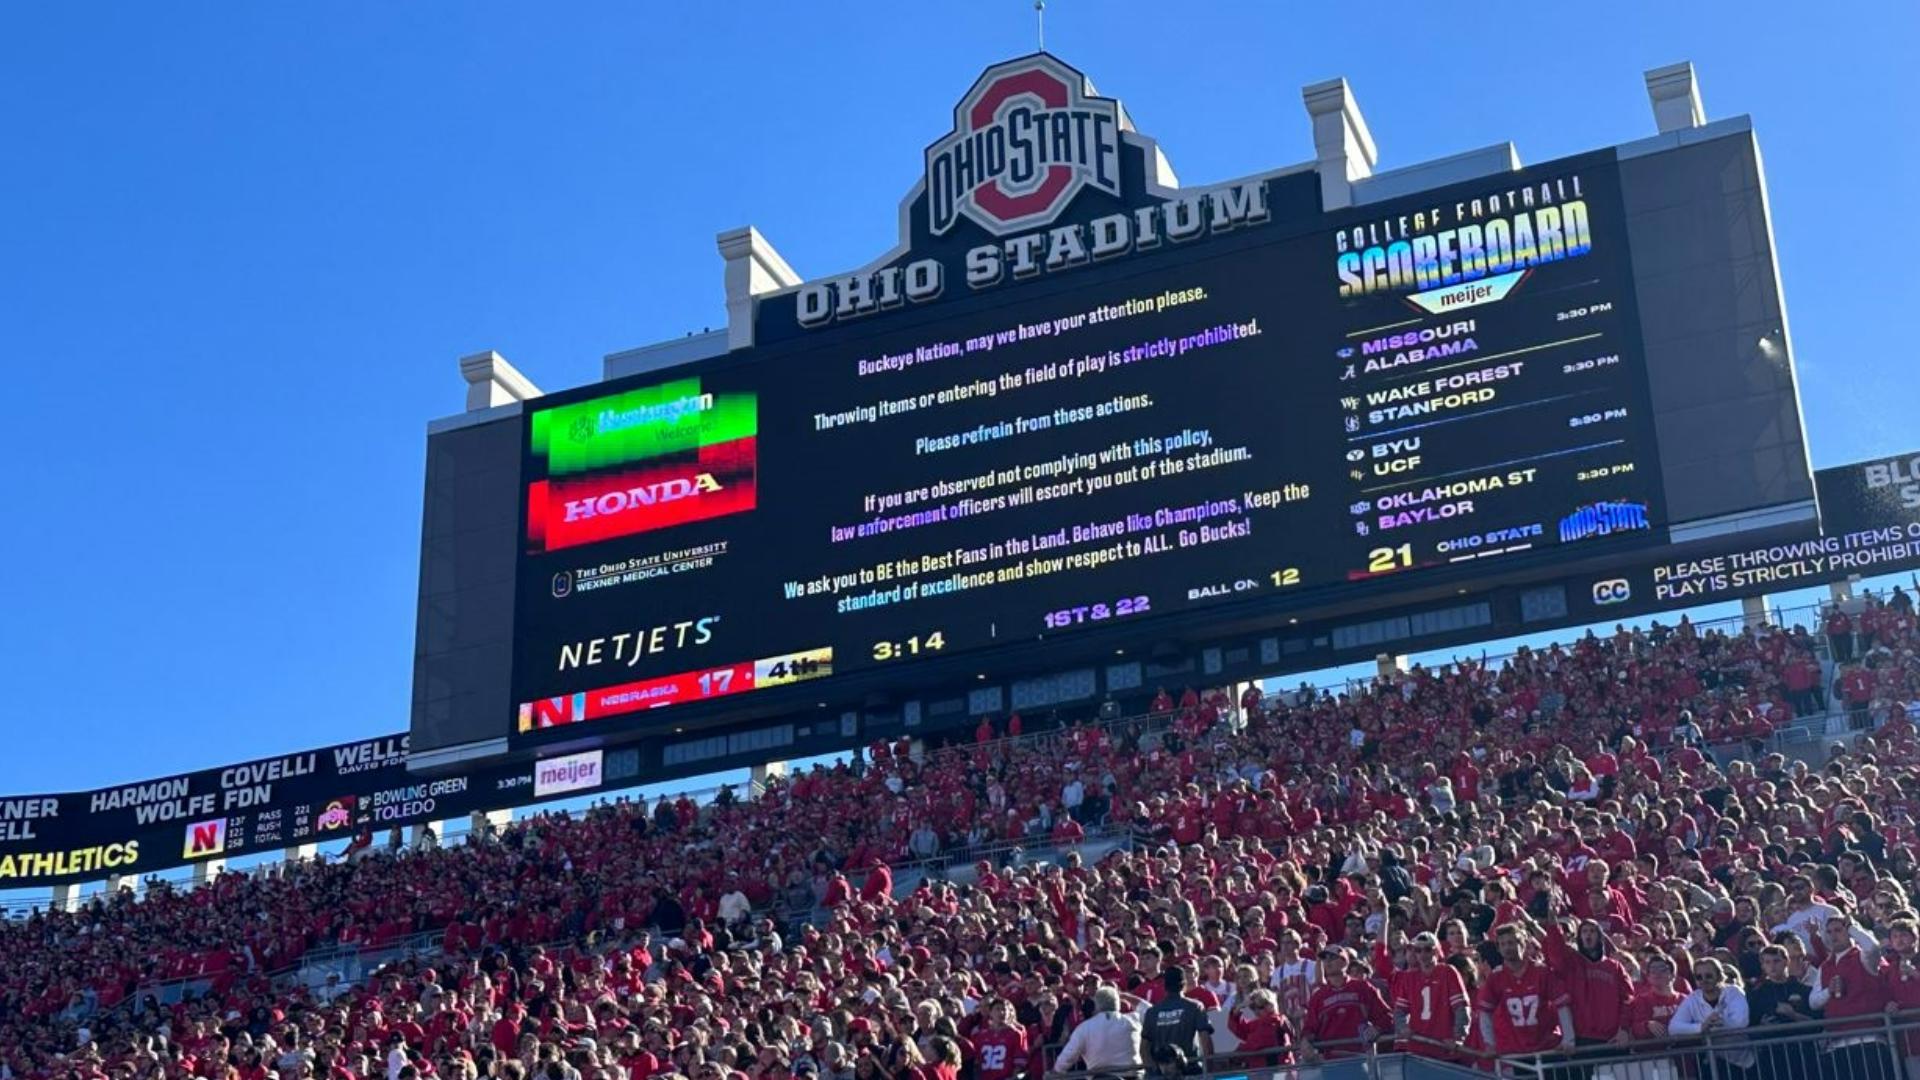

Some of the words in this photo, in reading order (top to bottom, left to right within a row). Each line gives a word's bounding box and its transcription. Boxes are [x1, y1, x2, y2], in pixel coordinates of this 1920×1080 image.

[797, 258, 945, 329] OHIO
[966, 180, 1271, 289] STADIUM
[1337, 200, 1592, 298] SCOREBOARD
[1440, 283, 1493, 307] meijer
[1590, 302, 1613, 314] PM
[857, 351, 914, 376] Buckeye
[914, 341, 964, 363] Nation,
[964, 333, 995, 352] may
[995, 328, 1017, 346] we
[1017, 320, 1052, 341] have
[1052, 312, 1086, 336] your
[1087, 297, 1154, 324] attention
[1155, 286, 1208, 313] please.
[1362, 320, 1476, 355] MISSOURI
[1364, 338, 1479, 373] ALABAMA
[1597, 354, 1620, 367] PM
[813, 405, 877, 431] Throwing
[878, 396, 917, 417] items
[917, 392, 936, 408] or
[936, 379, 997, 404] entering
[997, 373, 1022, 390] the
[1023, 363, 1056, 385] field
[1058, 359, 1075, 378] of
[1075, 354, 1106, 378] play
[1107, 351, 1122, 367] is
[1121, 338, 1177, 364] strictly
[1177, 320, 1262, 355] prohibited.
[1366, 382, 1431, 406] WAKE
[1435, 362, 1524, 393] FOREST
[915, 433, 961, 455] Please
[960, 421, 1014, 445] refrain
[1013, 414, 1052, 434] from
[1052, 405, 1094, 426] these
[1095, 393, 1153, 417] actions.
[1368, 387, 1496, 424] STANFORD
[1604, 407, 1628, 421] PM
[1371, 436, 1421, 459] BYU
[1373, 455, 1421, 476] UCF
[863, 496, 876, 513] If
[876, 491, 903, 513] you
[903, 486, 929, 504] are
[929, 472, 995, 499] observed
[996, 467, 1021, 485] not
[1022, 452, 1097, 480] complying
[1098, 444, 1132, 464] with
[1132, 438, 1163, 457] this
[1163, 428, 1213, 455] policy,
[1612, 462, 1635, 475] PM
[564, 473, 723, 523] HONDA
[830, 525, 856, 543] law
[856, 505, 948, 537] enforcement
[948, 494, 1006, 519] officers
[1006, 487, 1033, 507] will
[1034, 478, 1084, 501] escort
[1085, 473, 1112, 495] you
[1113, 467, 1138, 486] out
[1139, 463, 1156, 480] of
[1157, 458, 1184, 476] the
[1185, 445, 1252, 471] stadium.
[1377, 475, 1504, 511] OKLAHOMA
[1507, 468, 1537, 485] ST
[1378, 500, 1475, 530] BAYLOR
[783, 581, 805, 599] We
[806, 576, 831, 595] ask
[831, 572, 857, 594] you
[858, 568, 875, 584] to
[875, 563, 893, 581] BE
[894, 560, 919, 577] the
[920, 552, 953, 573] Best
[954, 546, 988, 566] Fans
[988, 543, 1003, 560] in
[1003, 538, 1030, 556] the
[1031, 529, 1071, 551] Land.
[1071, 519, 1125, 543] Behave
[1125, 514, 1153, 533] like
[1153, 497, 1242, 528] Champions,
[1243, 489, 1281, 510] Keep
[1282, 483, 1310, 502] the
[1436, 534, 1482, 553] OHIO
[1485, 523, 1544, 544] STATE
[1654, 557, 1726, 583] PLEASE
[1727, 536, 1839, 570] THROWING
[1844, 525, 1903, 549] ITEMS
[576, 568, 598, 579] THE
[600, 562, 627, 575] OHIO
[628, 555, 661, 569] STATE
[663, 541, 728, 562] UNIVERSITY
[576, 577, 621, 592] WEXNER
[622, 568, 670, 583] MEDICAL
[672, 557, 713, 573] CENTER
[836, 586, 901, 613] standard
[901, 583, 918, 601] of
[919, 570, 995, 597] excellence
[996, 563, 1023, 582] and
[1024, 557, 1064, 577] show
[1065, 544, 1124, 569] respect
[1124, 541, 1141, 557] to
[1142, 536, 1174, 555] ALL.
[1177, 530, 1198, 548] Go
[1199, 519, 1251, 544] Bucks!
[1368, 543, 1413, 573] 21
[1187, 583, 1231, 600] BALL
[1270, 568, 1300, 588] 12
[1595, 581, 1628, 601] CC
[1656, 578, 1706, 600] PLAY
[1709, 575, 1728, 591] IS
[1732, 558, 1824, 587] STRICTLY
[1044, 606, 1088, 629] 1ST
[1090, 602, 1111, 620] &
[1115, 595, 1151, 617] 22
[559, 616, 715, 671] NETJETS
[872, 631, 945, 662] 3:14
[768, 657, 818, 679] 4th
[601, 684, 679, 706] NEBRASKA
[699, 669, 734, 696] 17
[90, 777, 190, 813] HARMON
[221, 753, 316, 790] COVELLI
[374, 784, 427, 807] BOWLING
[429, 776, 468, 797] GREEN
[540, 761, 596, 785] meijer
[135, 793, 216, 825] WOLFE
[223, 783, 272, 811] FDN
[373, 798, 435, 822] TOLEDO
[192, 823, 218, 853] N
[258, 809, 282, 821] PASS
[0, 840, 139, 878] ATHLETICS
[1420, 985, 1432, 1020] 1
[1506, 995, 1539, 1026] 97
[981, 1044, 1007, 1070] 32
